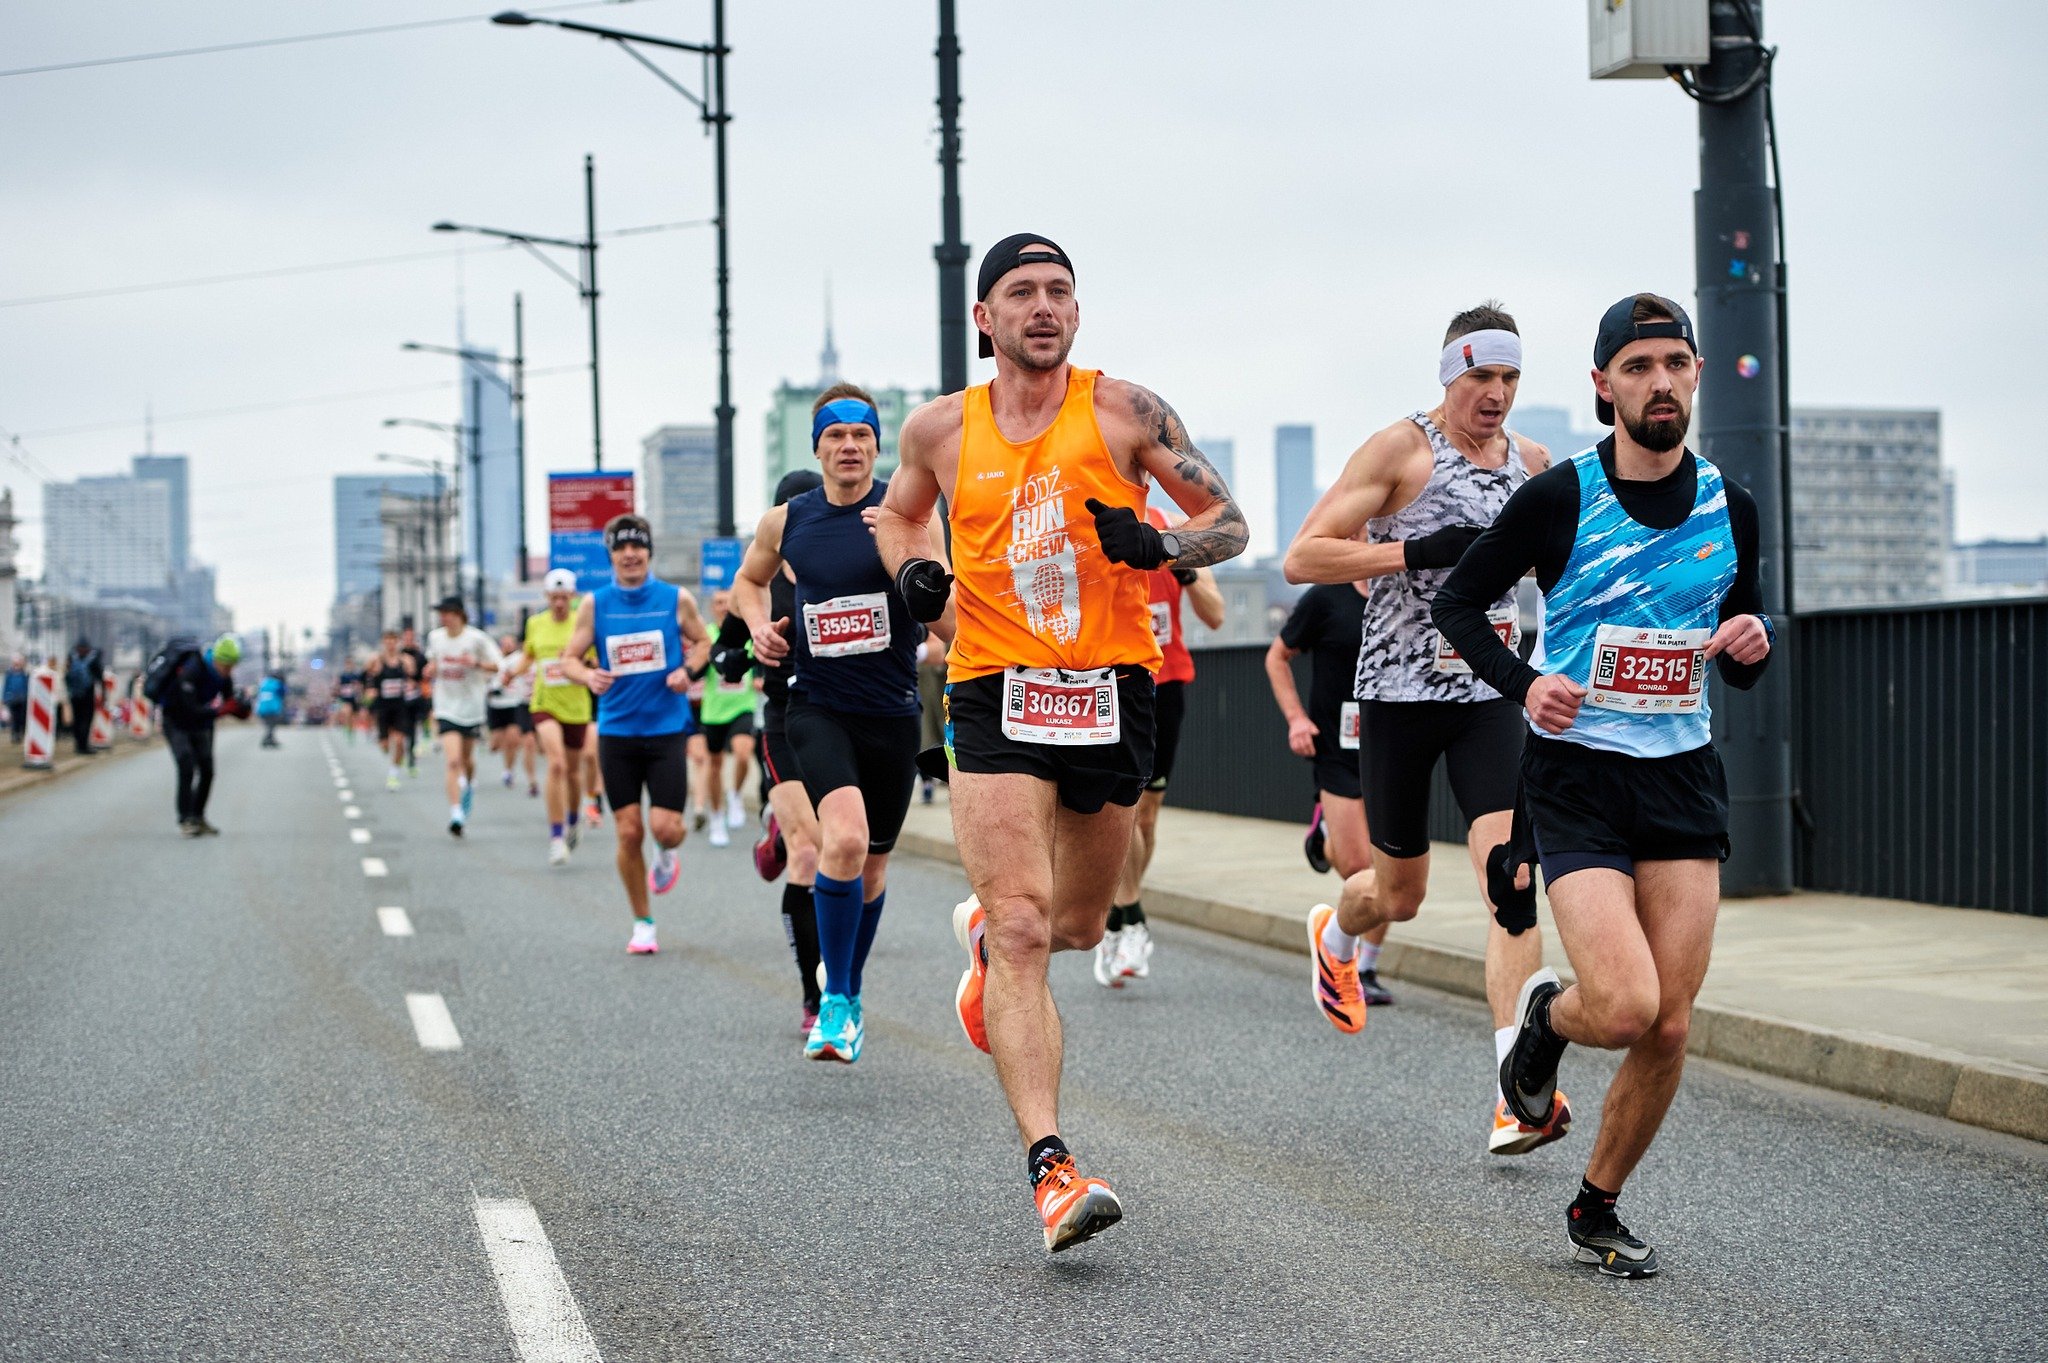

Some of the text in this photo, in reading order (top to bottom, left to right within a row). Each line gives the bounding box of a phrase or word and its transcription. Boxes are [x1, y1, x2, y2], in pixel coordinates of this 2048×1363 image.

[986, 470, 1005, 479] JAKO
[1012, 496, 1065, 544] RUN
[1013, 533, 1067, 563] CREW
[820, 613, 871, 636] 35952
[1620, 655, 1688, 682] 32515
[1637, 683, 1669, 691] KONRAD
[1027, 691, 1094, 717] 30867
